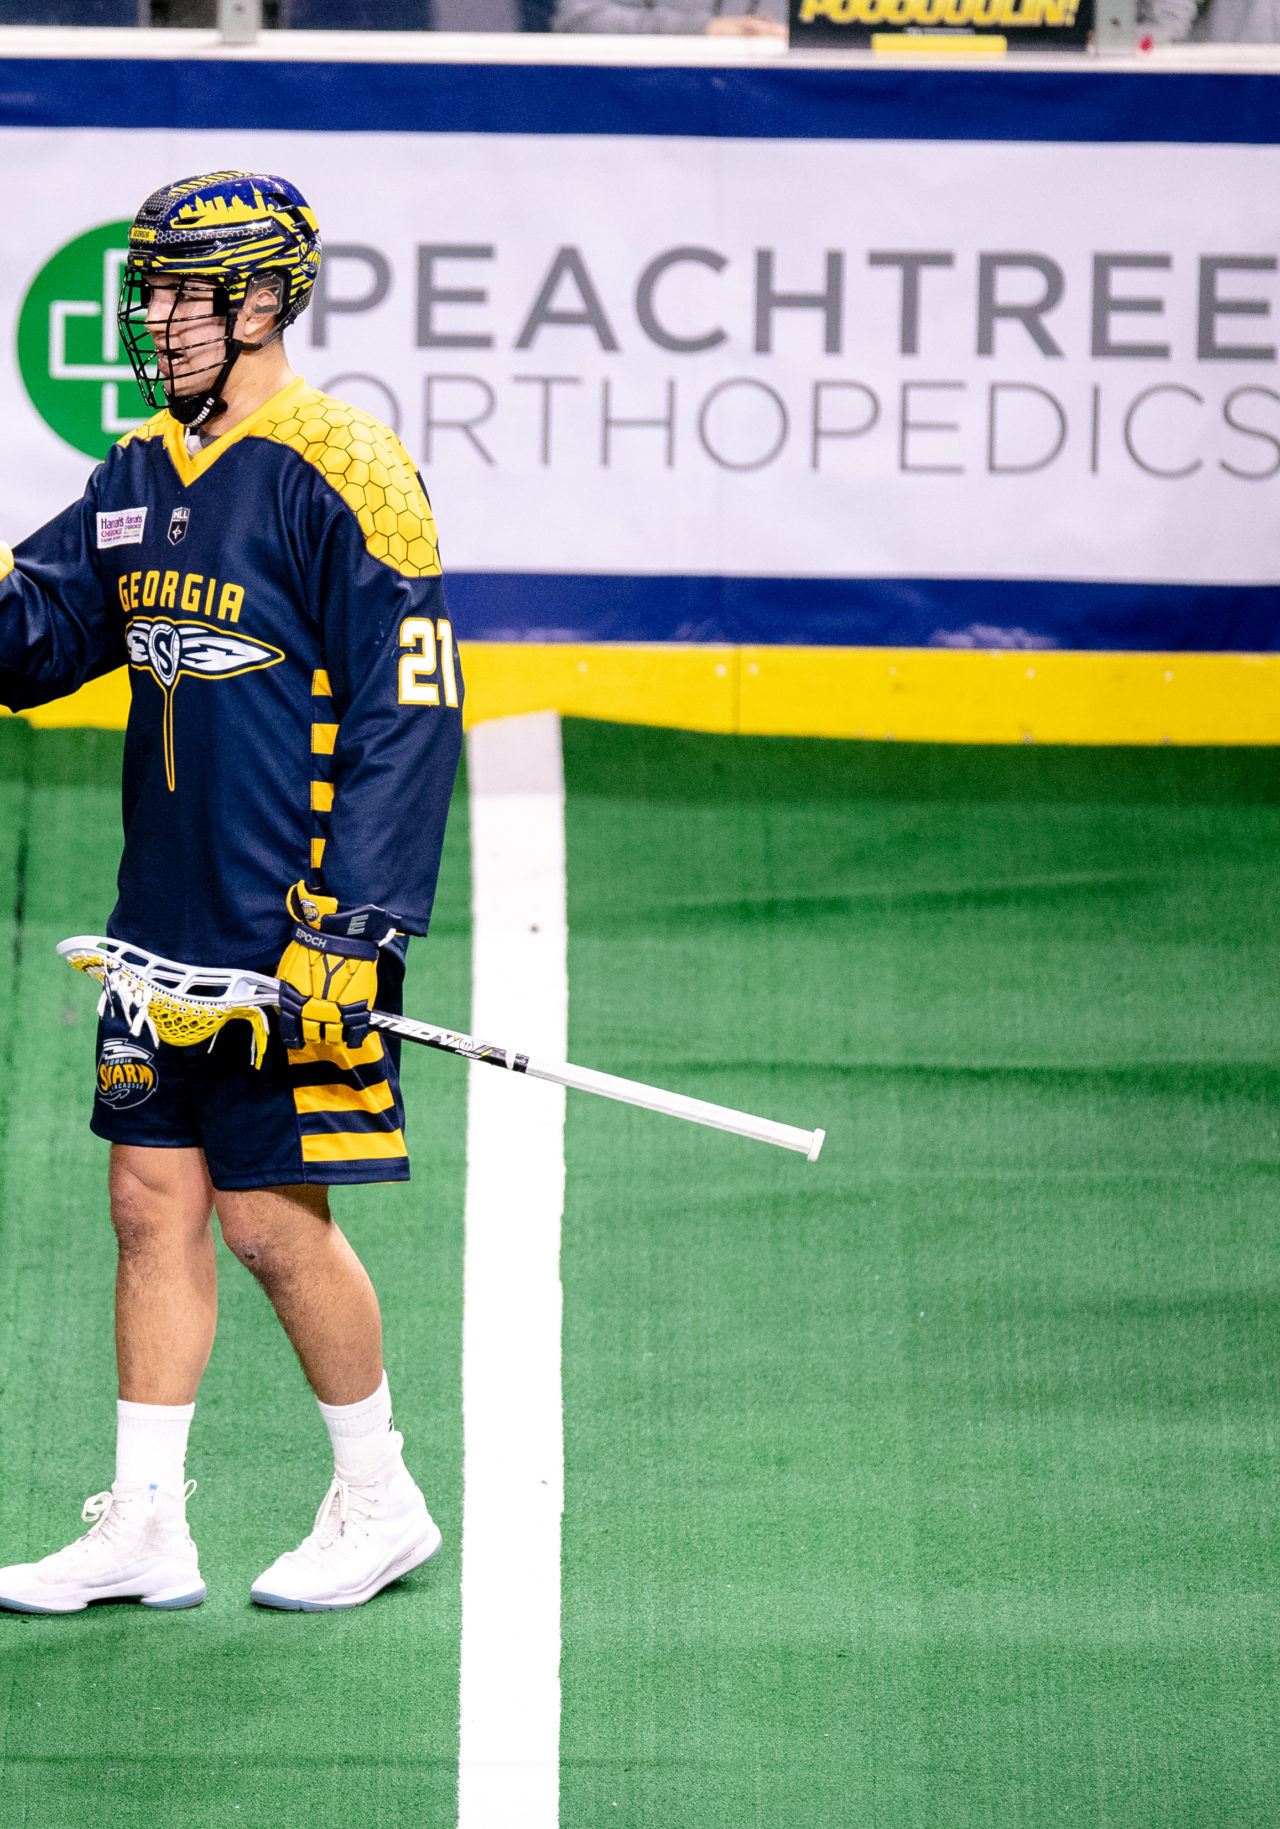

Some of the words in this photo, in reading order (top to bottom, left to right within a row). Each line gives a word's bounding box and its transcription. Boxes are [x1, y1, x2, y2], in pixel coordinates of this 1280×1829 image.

[311, 243, 1278, 361] PEACHTREE
[322, 373, 1280, 481] ORTHOPEDICS
[118, 570, 245, 623] GEORGIA
[398, 616, 459, 709] 21
[295, 928, 327, 948] EPOCH
